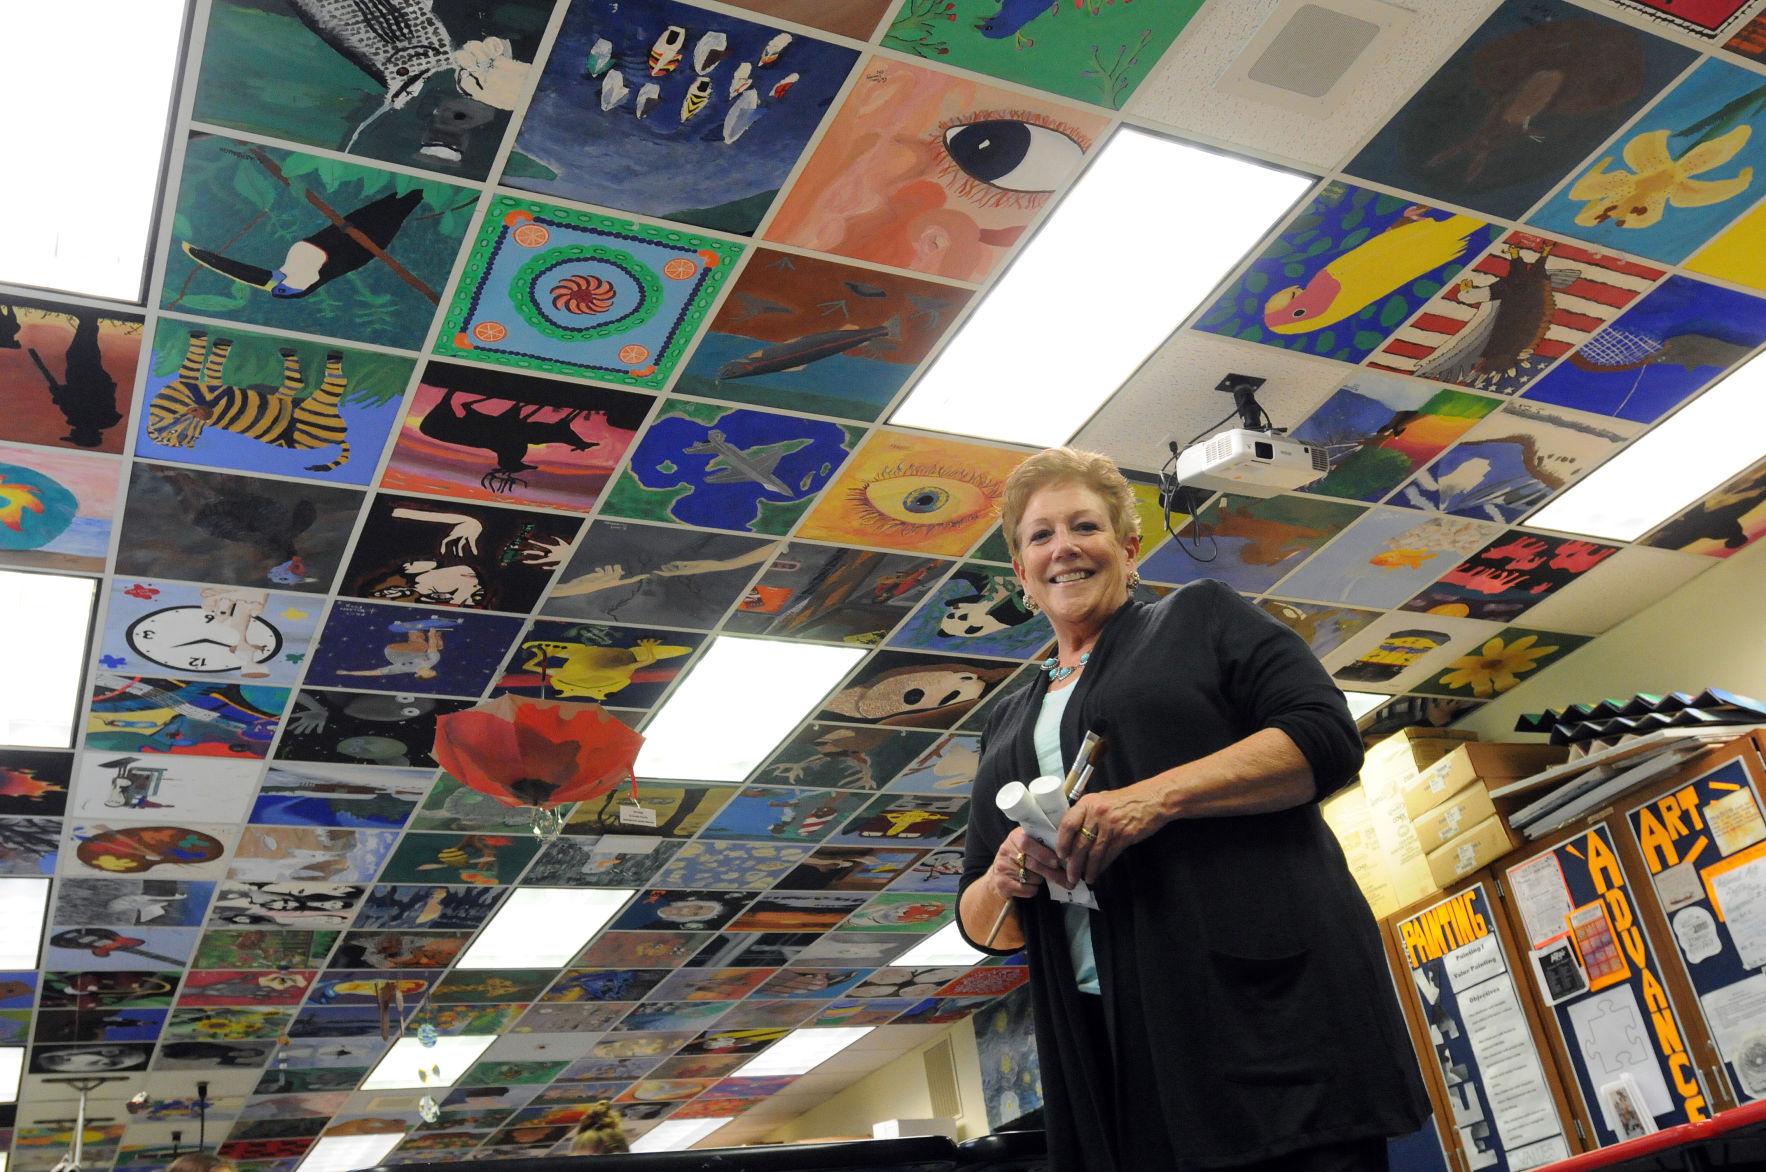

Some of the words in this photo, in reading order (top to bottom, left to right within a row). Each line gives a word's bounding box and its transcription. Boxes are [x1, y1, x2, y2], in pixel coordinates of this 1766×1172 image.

[189, 657, 207, 667] 12
[1639, 785, 1704, 874] ART
[1401, 890, 1488, 968] PAINTING
[1456, 946, 1481, 961] Painting
[1453, 968, 1470, 980] Value
[1470, 957, 1497, 972] Painting
[1469, 987, 1501, 1003] Objectives
